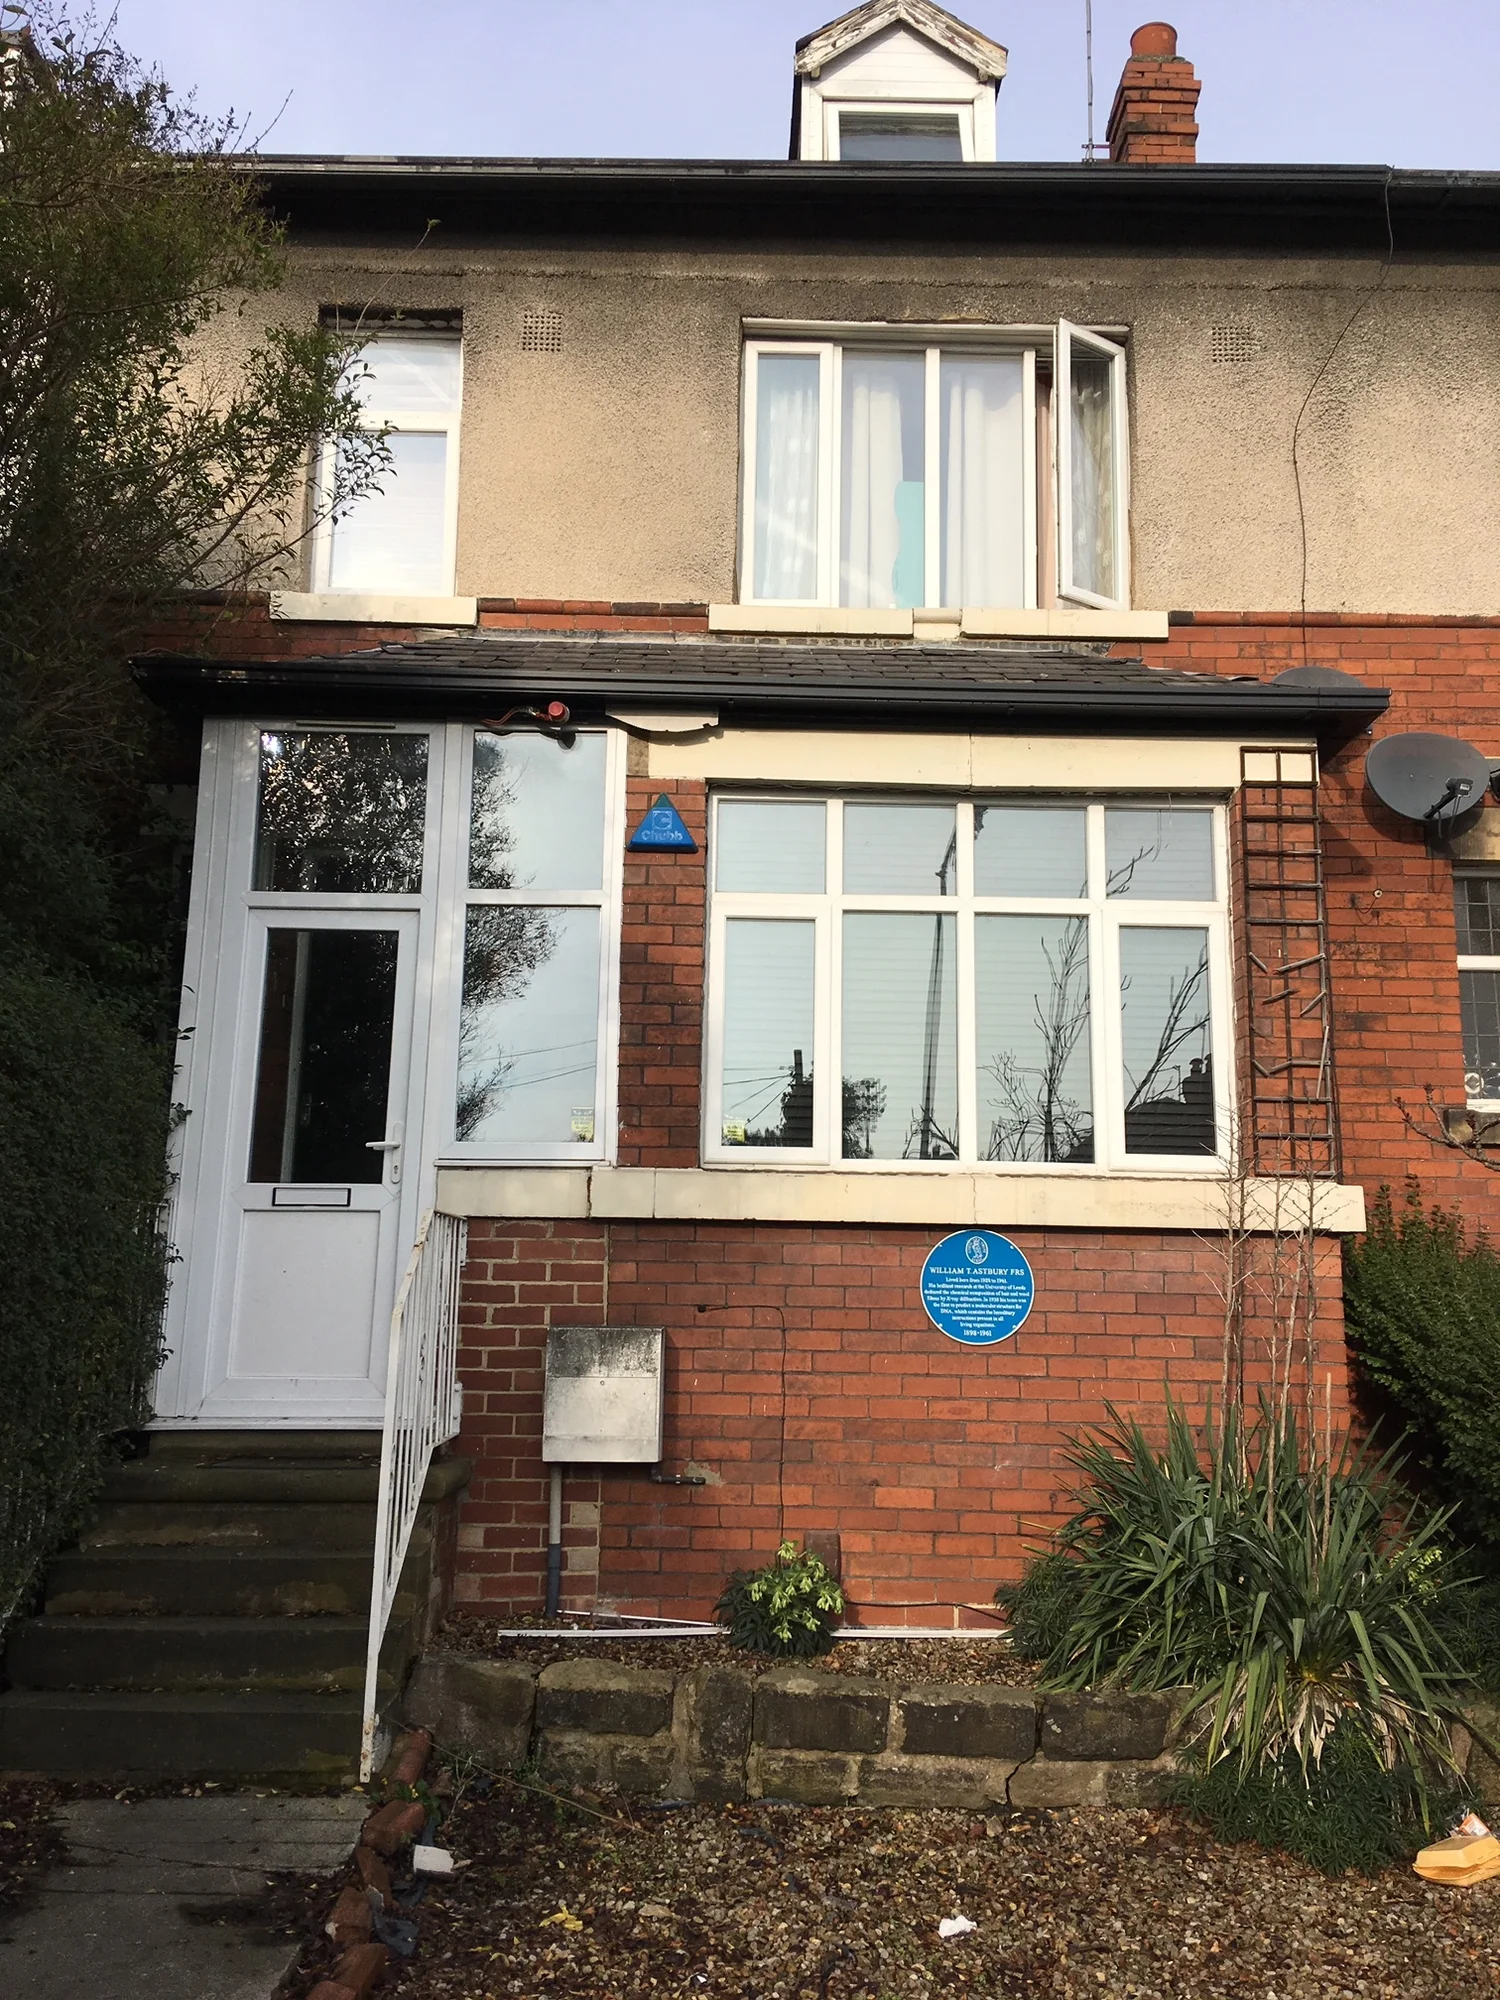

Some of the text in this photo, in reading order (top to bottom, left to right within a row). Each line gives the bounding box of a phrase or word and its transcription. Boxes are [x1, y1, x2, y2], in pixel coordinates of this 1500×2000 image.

[641, 829, 683, 841] Chubb
[929, 1266, 964, 1274] WILLIAM
[972, 1267, 1009, 1275] ASTBURY
[1010, 1268, 1025, 1276] FRS
